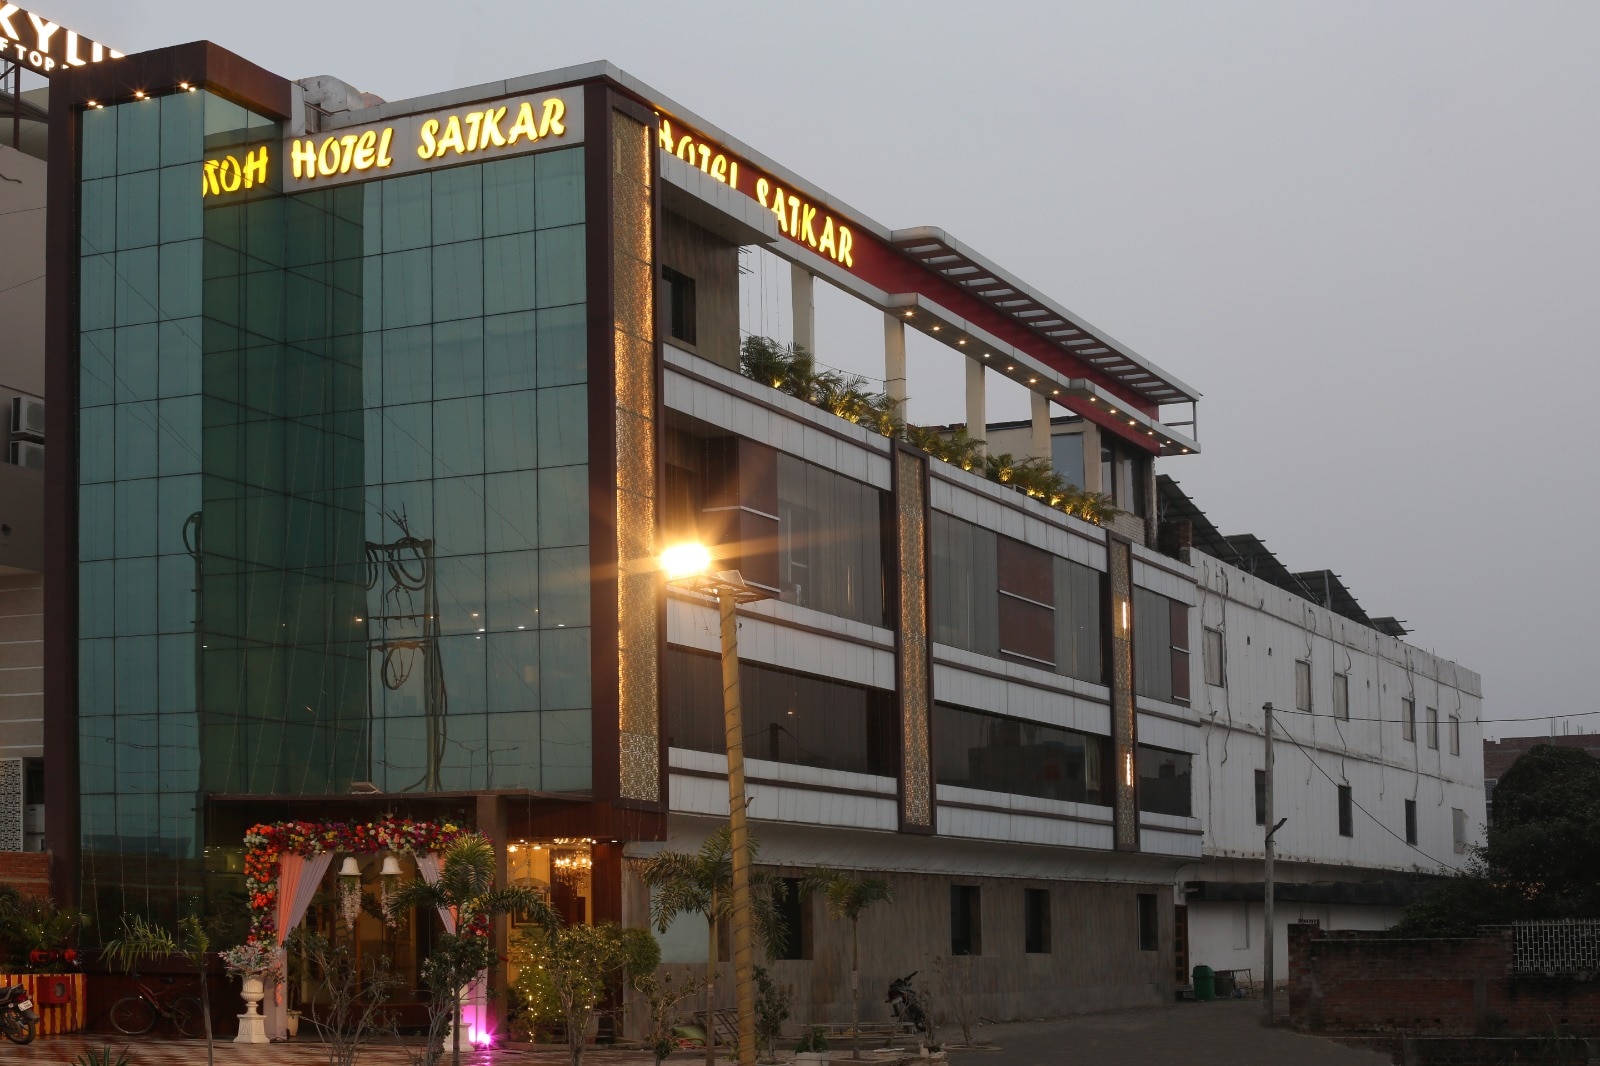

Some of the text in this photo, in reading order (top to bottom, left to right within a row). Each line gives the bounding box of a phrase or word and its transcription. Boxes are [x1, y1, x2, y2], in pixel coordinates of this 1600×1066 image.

[0, 3, 126, 66] KYLI
[291, 98, 566, 179] HOTEL SATKAR
[756, 178, 853, 268] SATKAR
